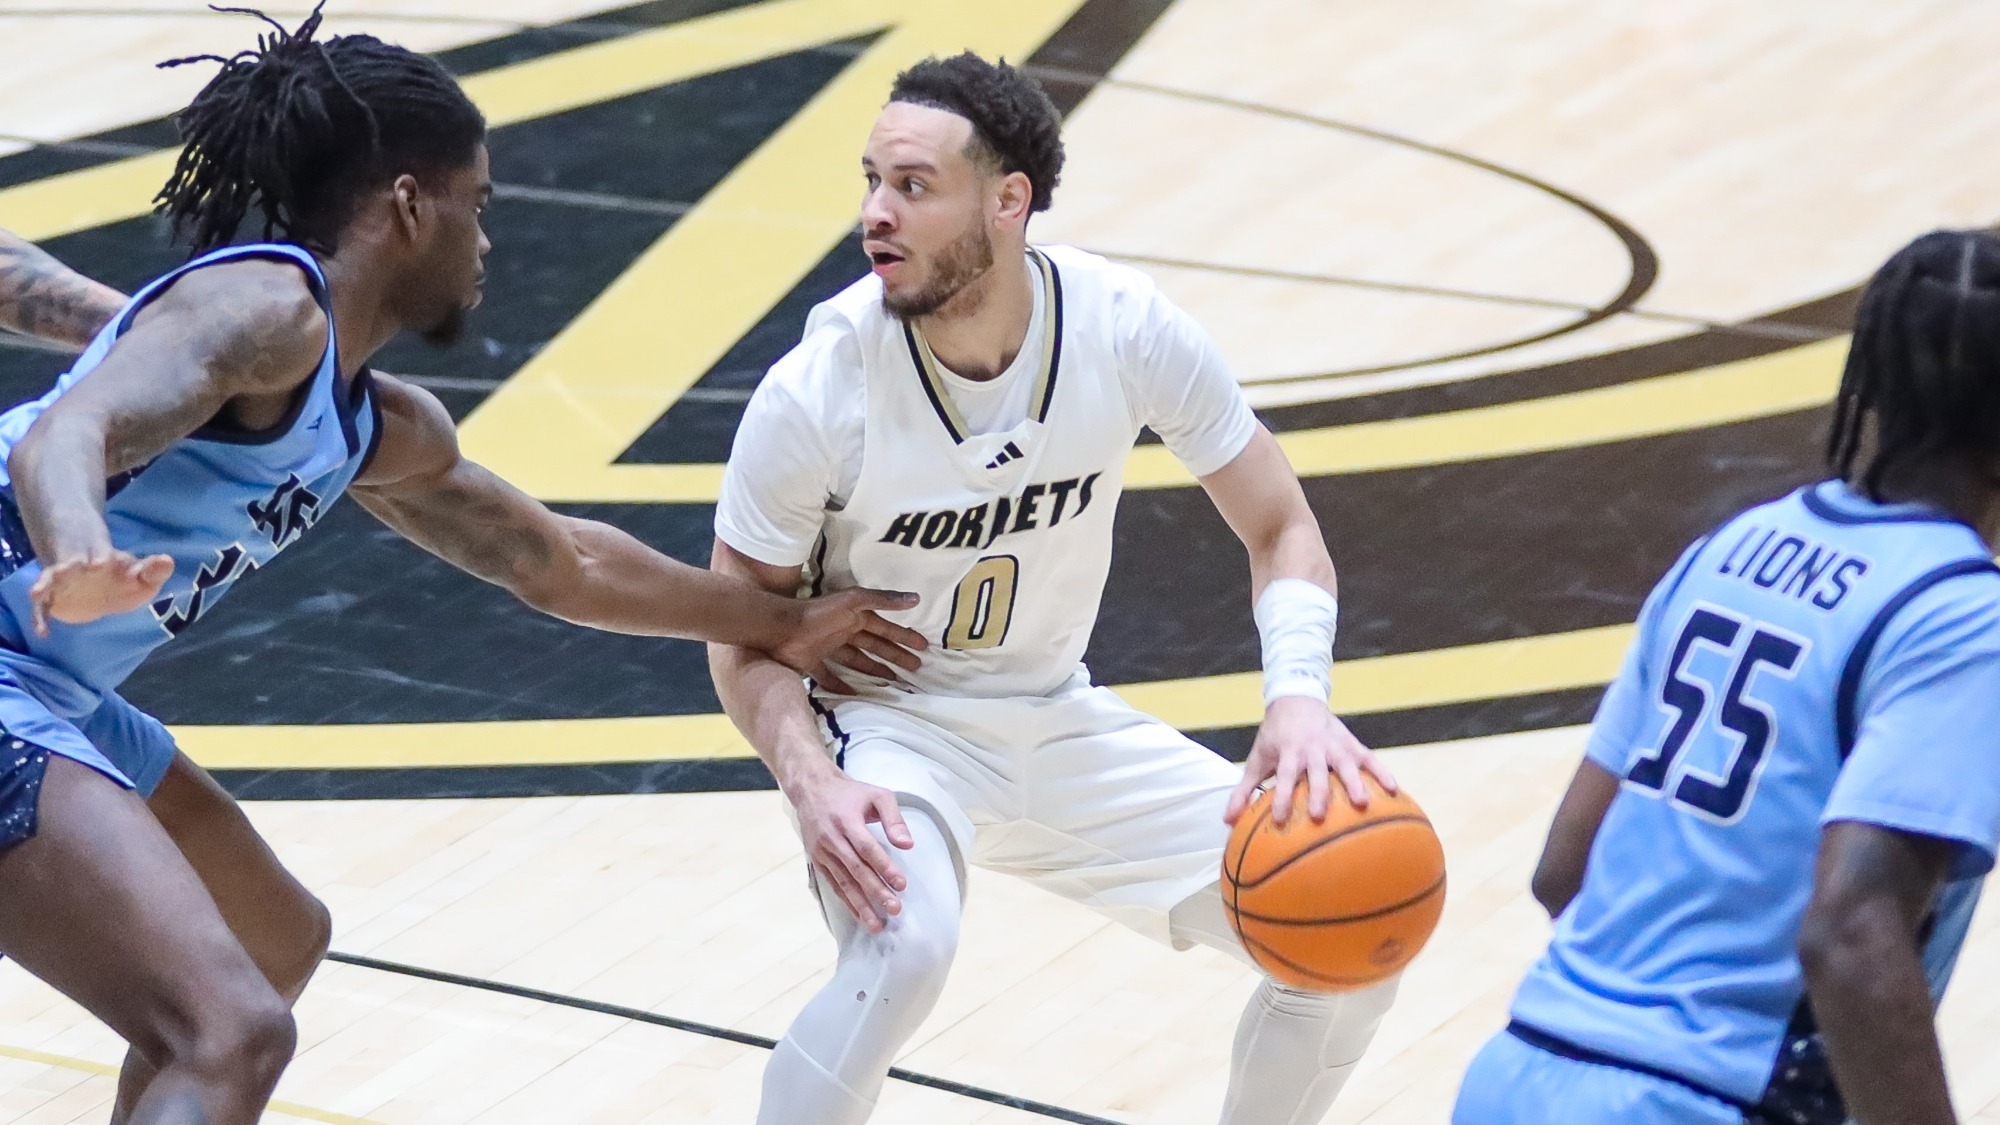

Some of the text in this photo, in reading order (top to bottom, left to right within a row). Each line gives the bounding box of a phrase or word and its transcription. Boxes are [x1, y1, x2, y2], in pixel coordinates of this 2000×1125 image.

[942, 554, 1020, 651] 0
[1718, 526, 1868, 611] LIONS
[1622, 600, 1813, 826] 55
